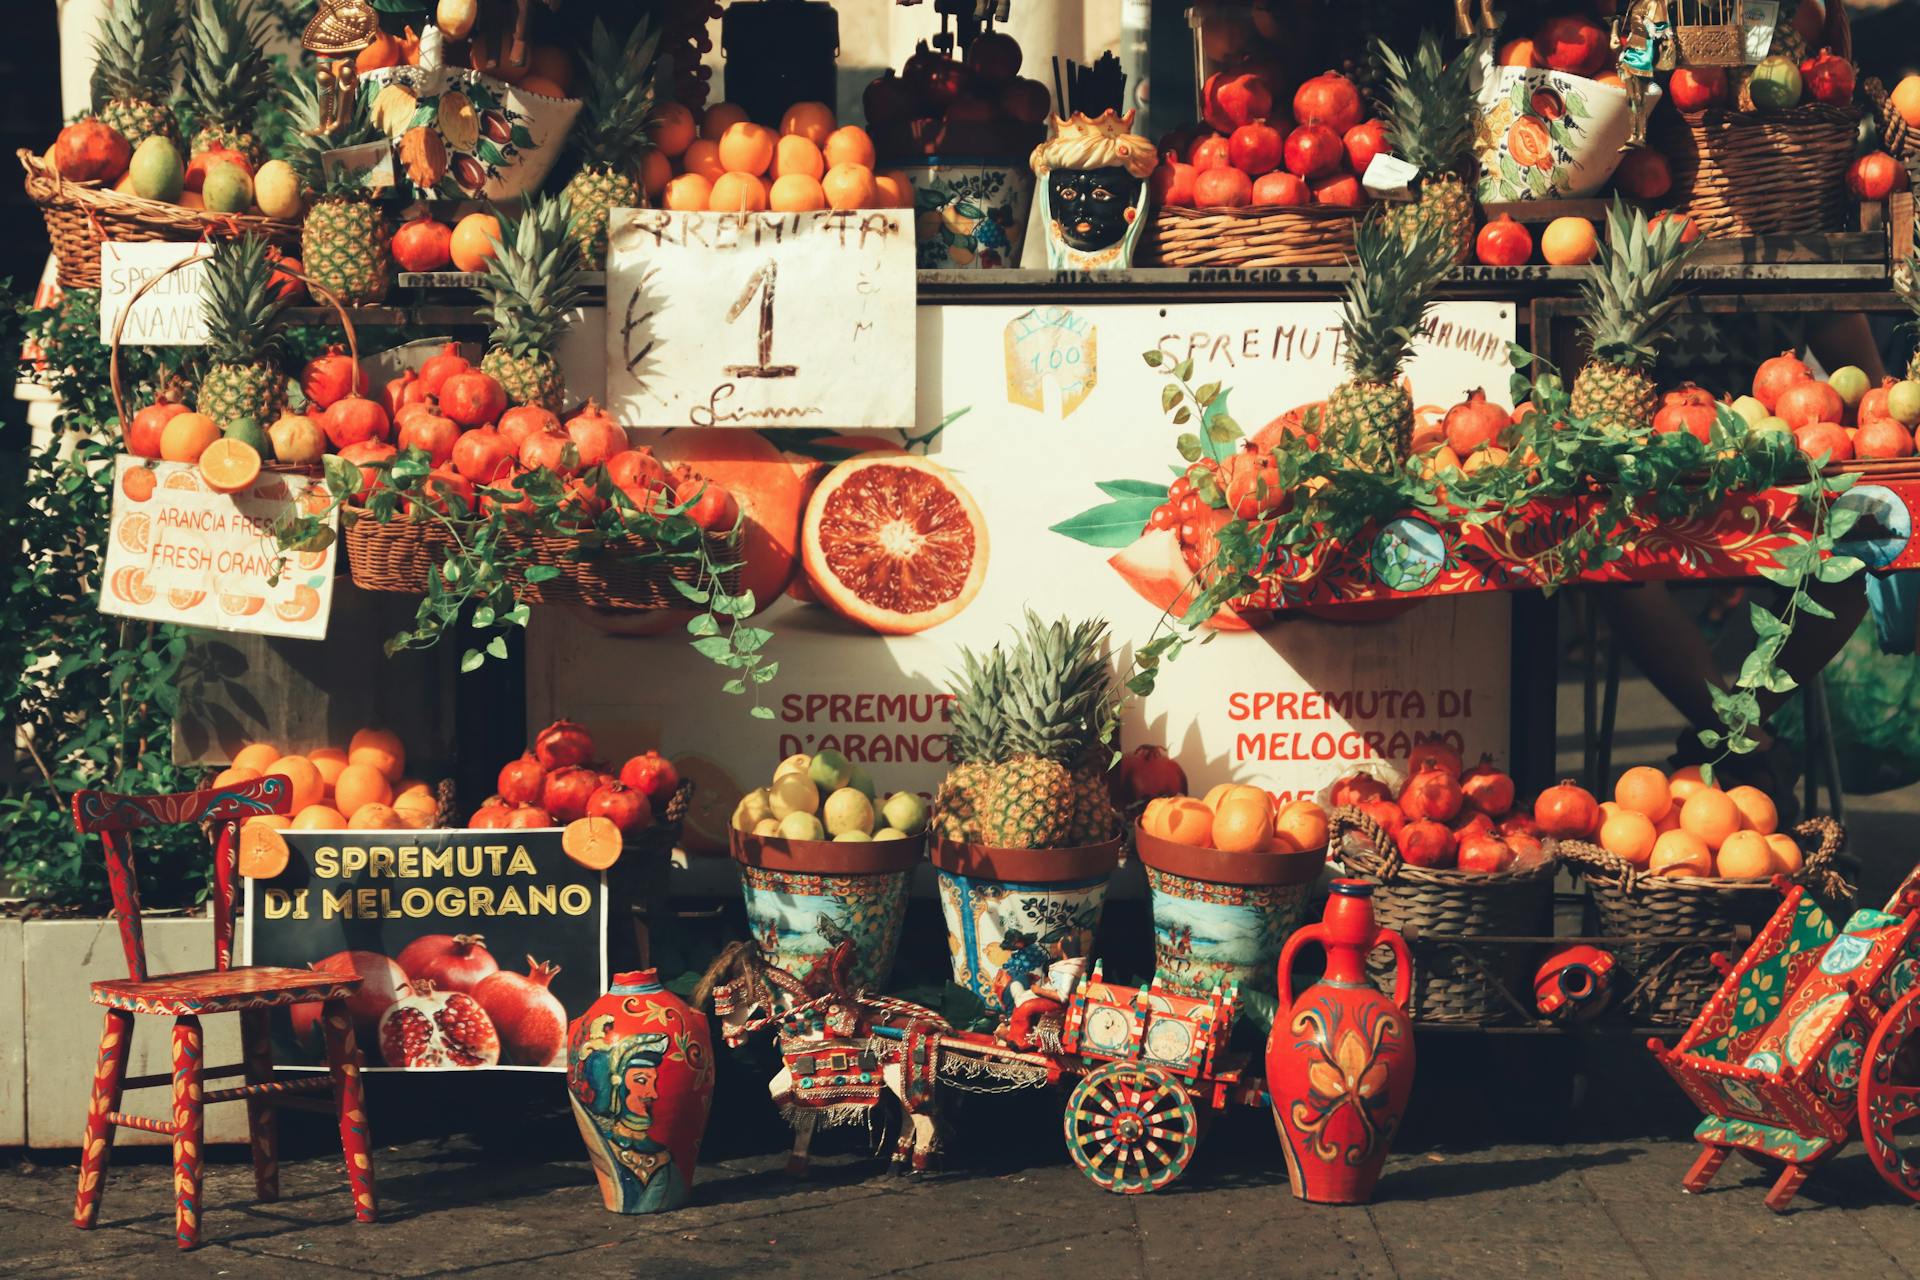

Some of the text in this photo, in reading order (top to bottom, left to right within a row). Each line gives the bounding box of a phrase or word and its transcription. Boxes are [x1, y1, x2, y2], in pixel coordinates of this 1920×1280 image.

[109, 267, 202, 294] SPREMUT
[722, 256, 800, 379] 1
[1157, 324, 1347, 374] SPREMUT
[157, 507, 294, 539] ARANCIA FRES
[152, 543, 294, 581] FRESH ORANGE
[778, 693, 958, 723] SPREMUT
[1228, 688, 1473, 721] SPREMUTA DI
[314, 845, 537, 879] SPREMUTA
[264, 884, 592, 920] DI MELOGRANO
